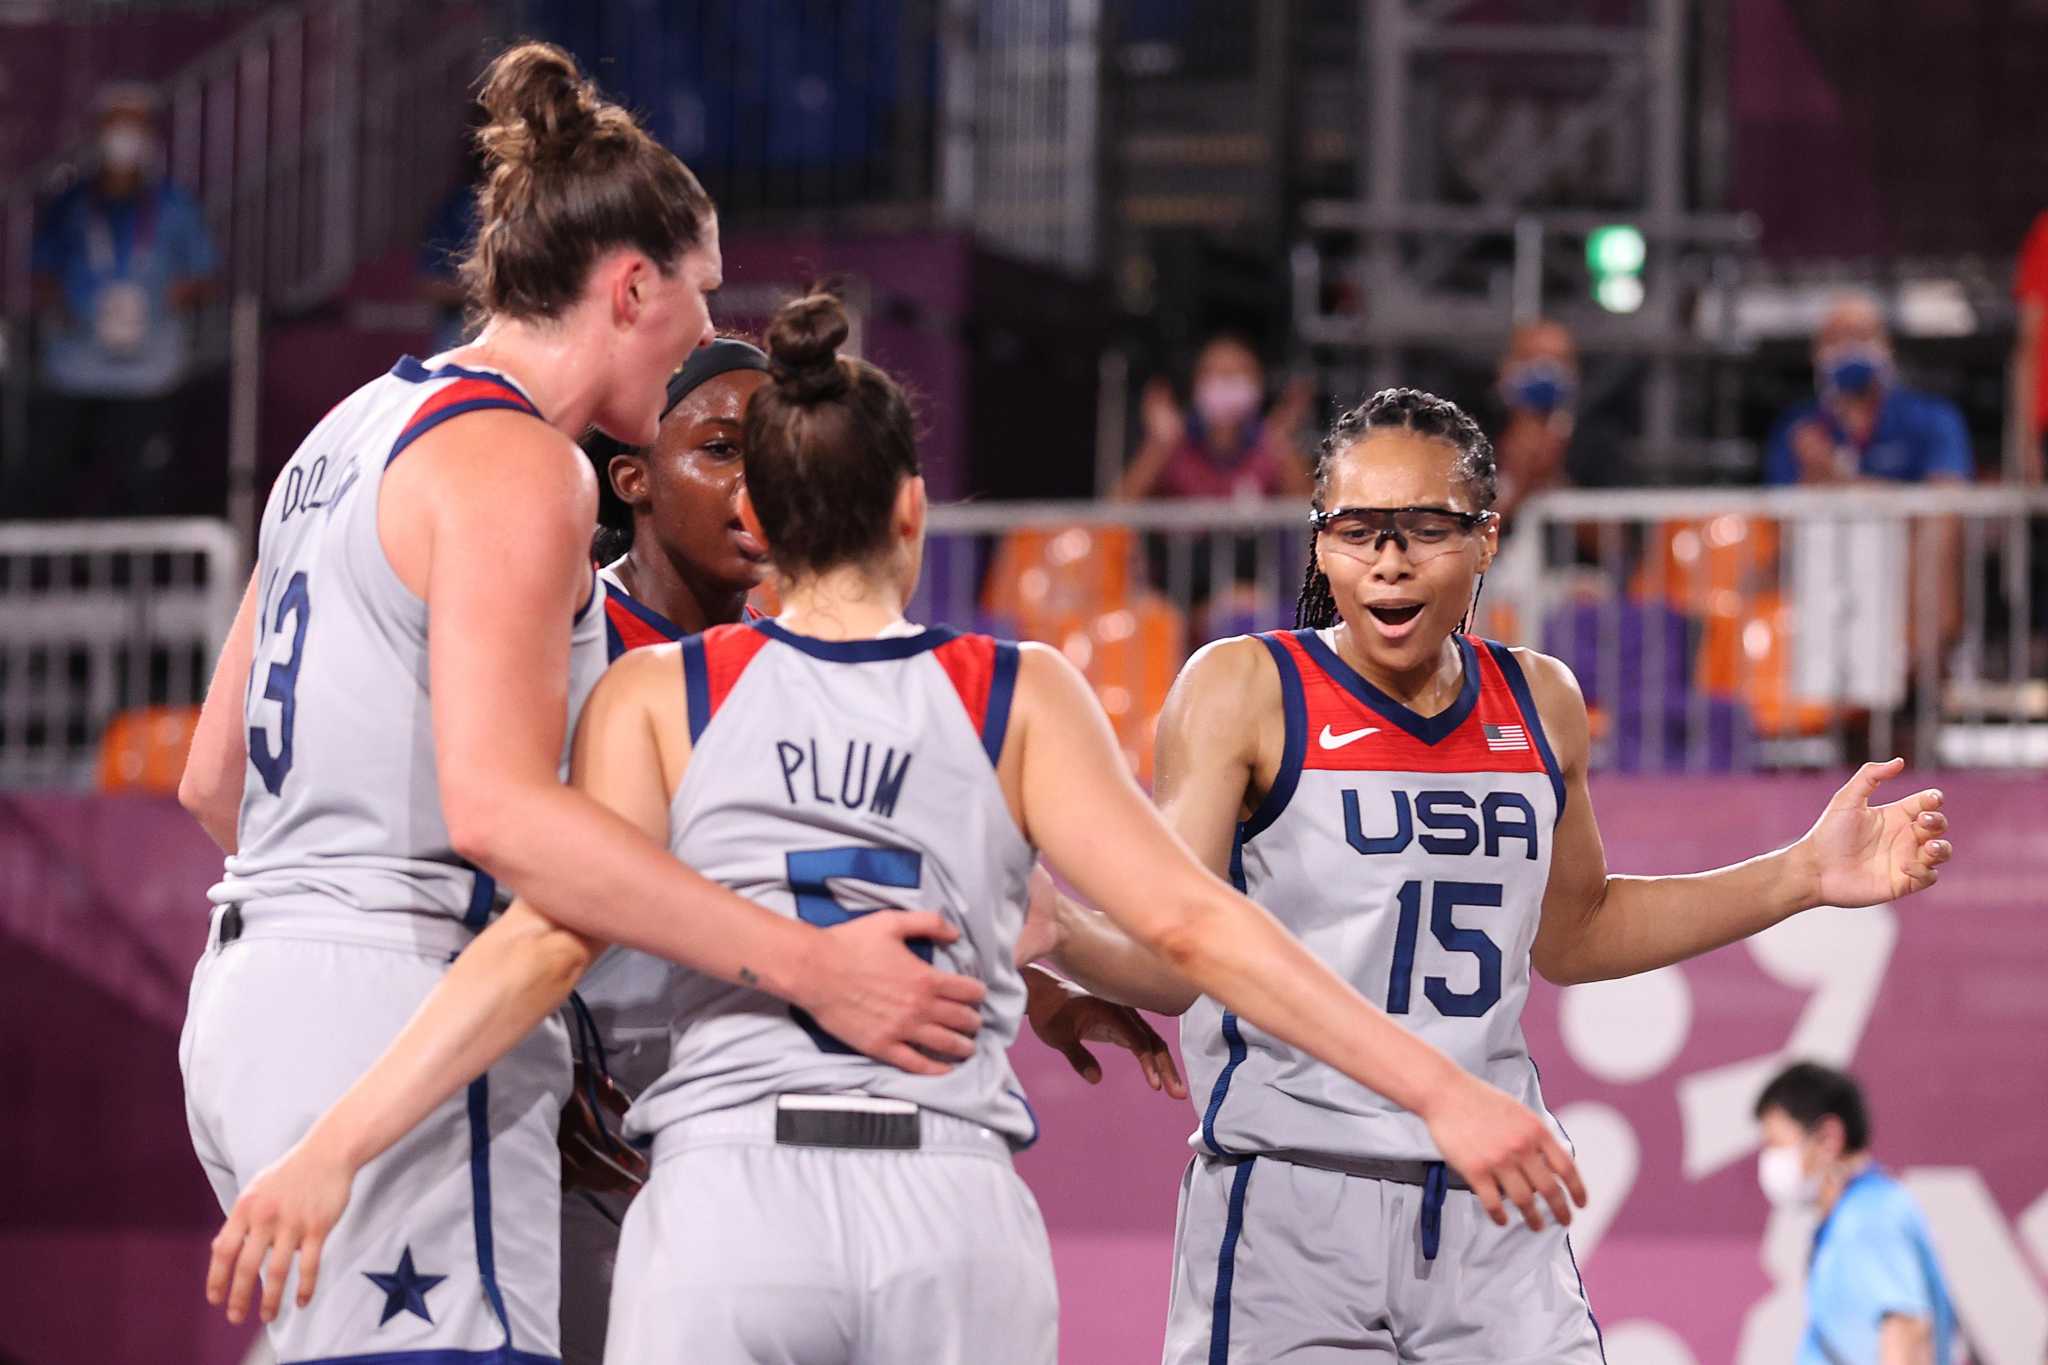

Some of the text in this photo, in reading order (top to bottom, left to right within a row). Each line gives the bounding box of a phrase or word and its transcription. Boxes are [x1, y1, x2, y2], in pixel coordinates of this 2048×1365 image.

[776, 737, 912, 818] PLUM
[1341, 788, 1538, 861] USA
[1386, 879, 1503, 1018] 15
